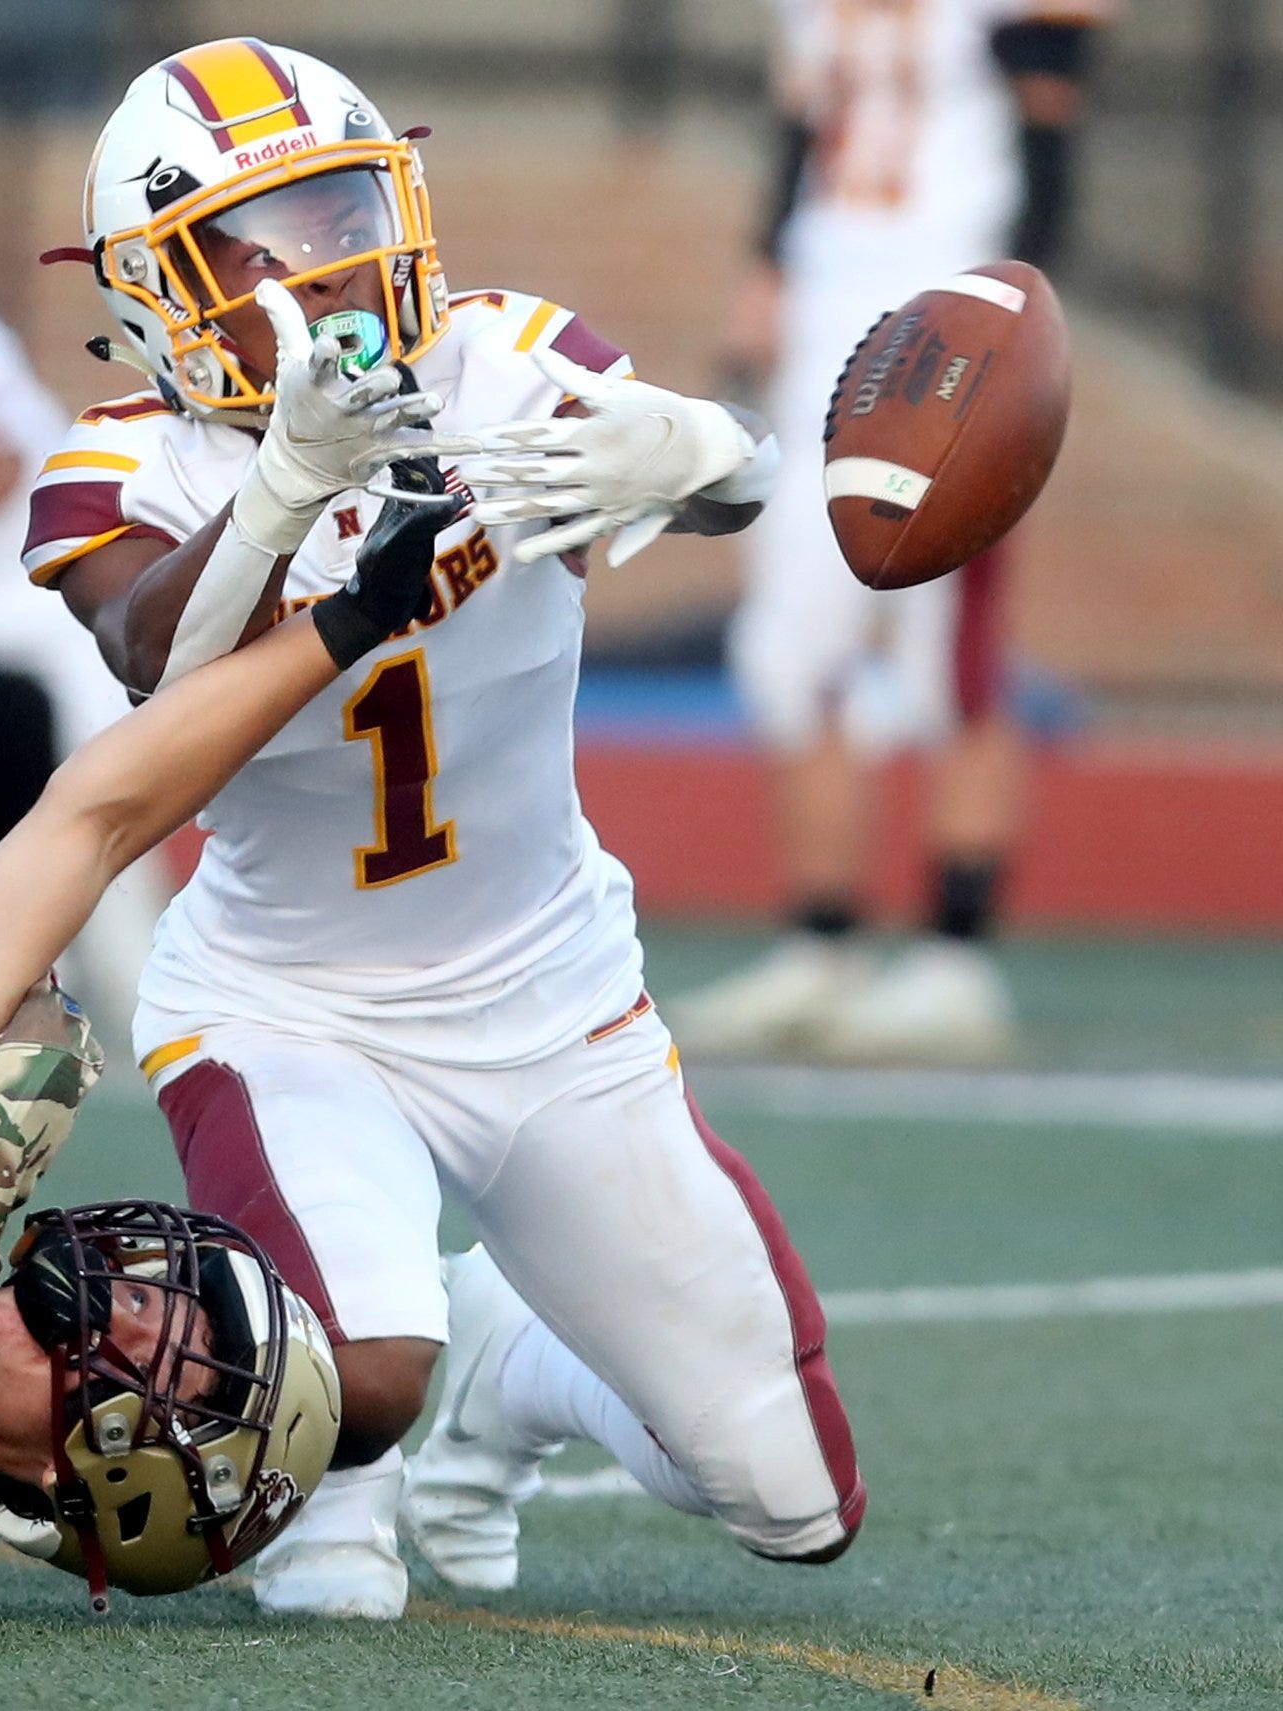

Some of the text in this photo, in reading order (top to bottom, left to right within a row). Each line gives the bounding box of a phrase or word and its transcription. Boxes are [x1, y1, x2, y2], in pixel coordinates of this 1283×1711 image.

[235, 131, 317, 170] Riddell
[332, 505, 364, 541] N
[342, 646, 459, 890] 1
